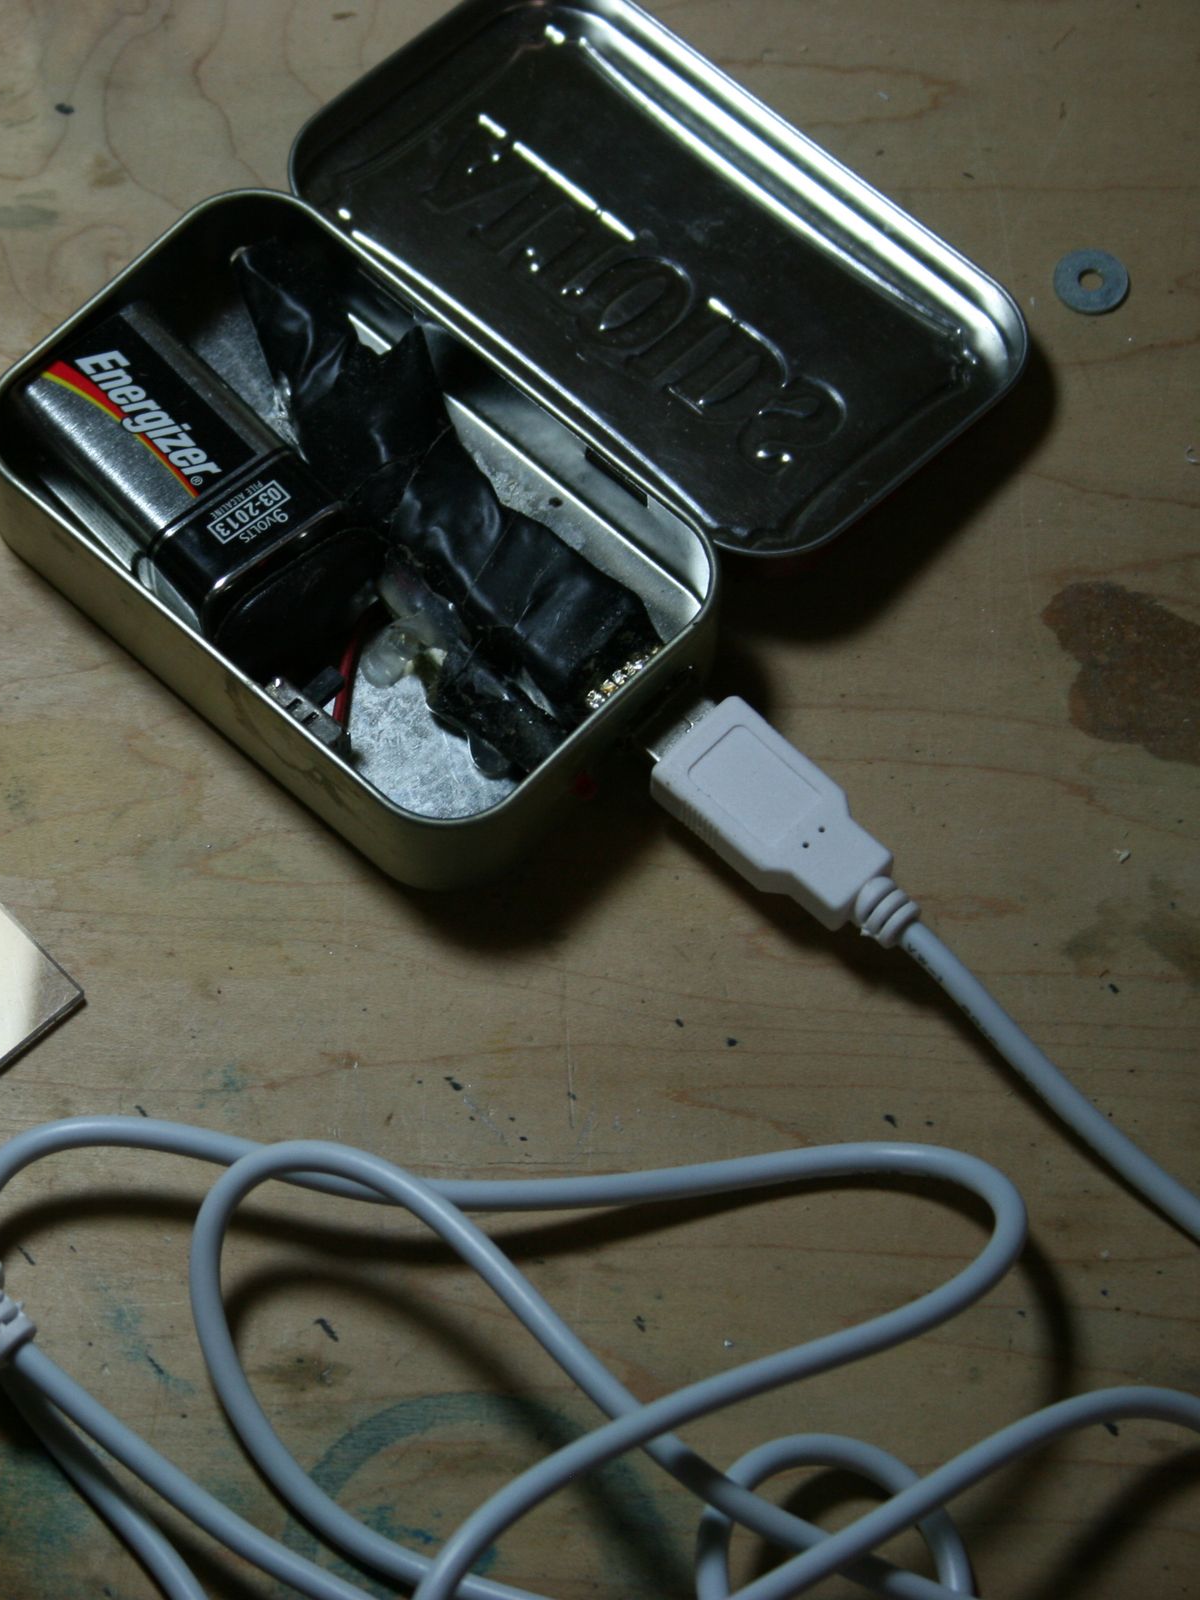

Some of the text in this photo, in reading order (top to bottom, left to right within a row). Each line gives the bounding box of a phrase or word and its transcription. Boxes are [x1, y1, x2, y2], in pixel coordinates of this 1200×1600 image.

[74, 350, 222, 475] Energizer
[210, 480, 264, 520] PILE ALCALINE
[215, 487, 282, 536] 03-2013
